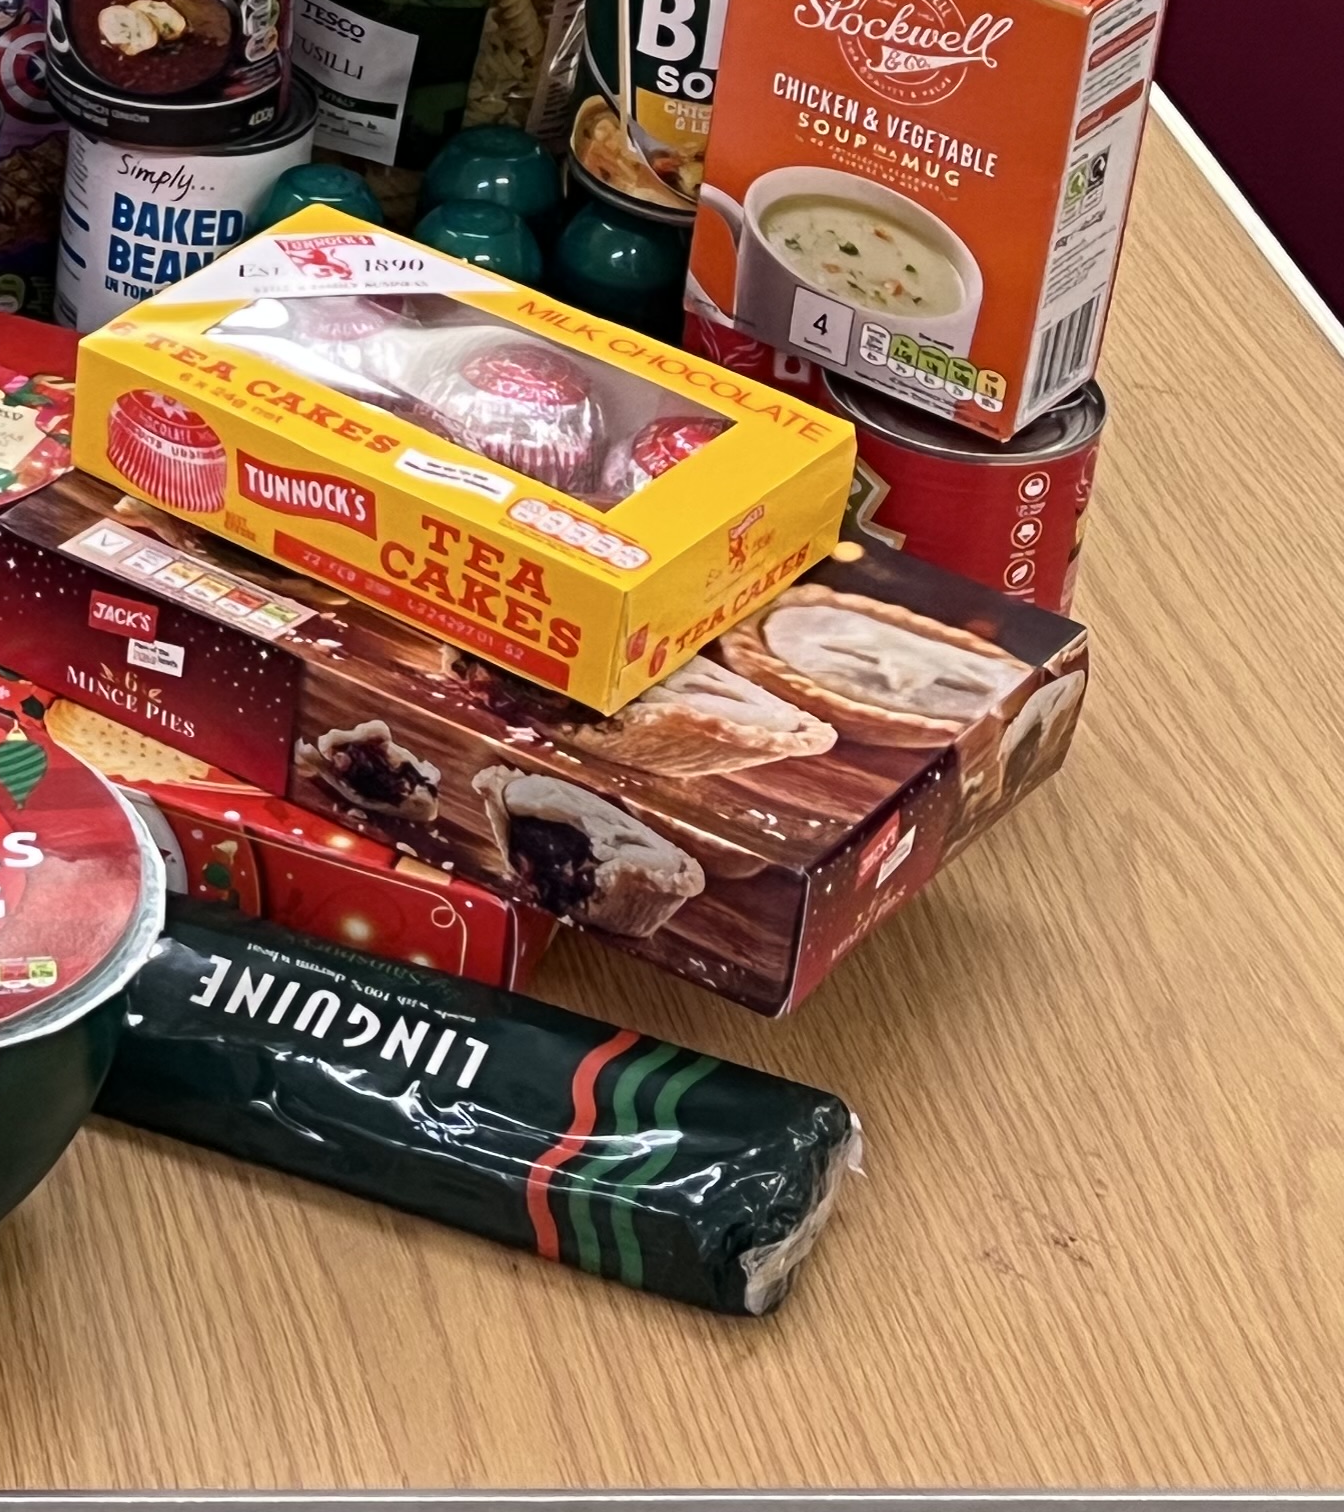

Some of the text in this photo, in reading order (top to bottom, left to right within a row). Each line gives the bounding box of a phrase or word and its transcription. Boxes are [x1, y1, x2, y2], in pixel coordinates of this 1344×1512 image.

[773, 72, 859, 124] CHICKEN
[863, 108, 879, 133] &
[887, 114, 999, 178] VEGETABLE
[798, 112, 868, 148] SOUP
[900, 154, 961, 187] MUG
[114, 192, 244, 247] BAKED
[108, 235, 220, 285] BEAN
[364, 258, 425, 274] 1890
[813, 313, 828, 336] 4
[108, 321, 402, 454] 6 TEA CAKES
[517, 299, 599, 345] MILK
[616, 339, 833, 447] CHOCOLATE
[243, 462, 366, 523] TUNNOCK'S
[421, 515, 552, 605] TEA
[92, 599, 152, 634] JACK'S
[379, 540, 582, 659] CAKES
[649, 541, 811, 678] 6 TEA CAKES
[66, 664, 197, 740] MINCE PIES
[189, 954, 489, 1090] LINGUINE
